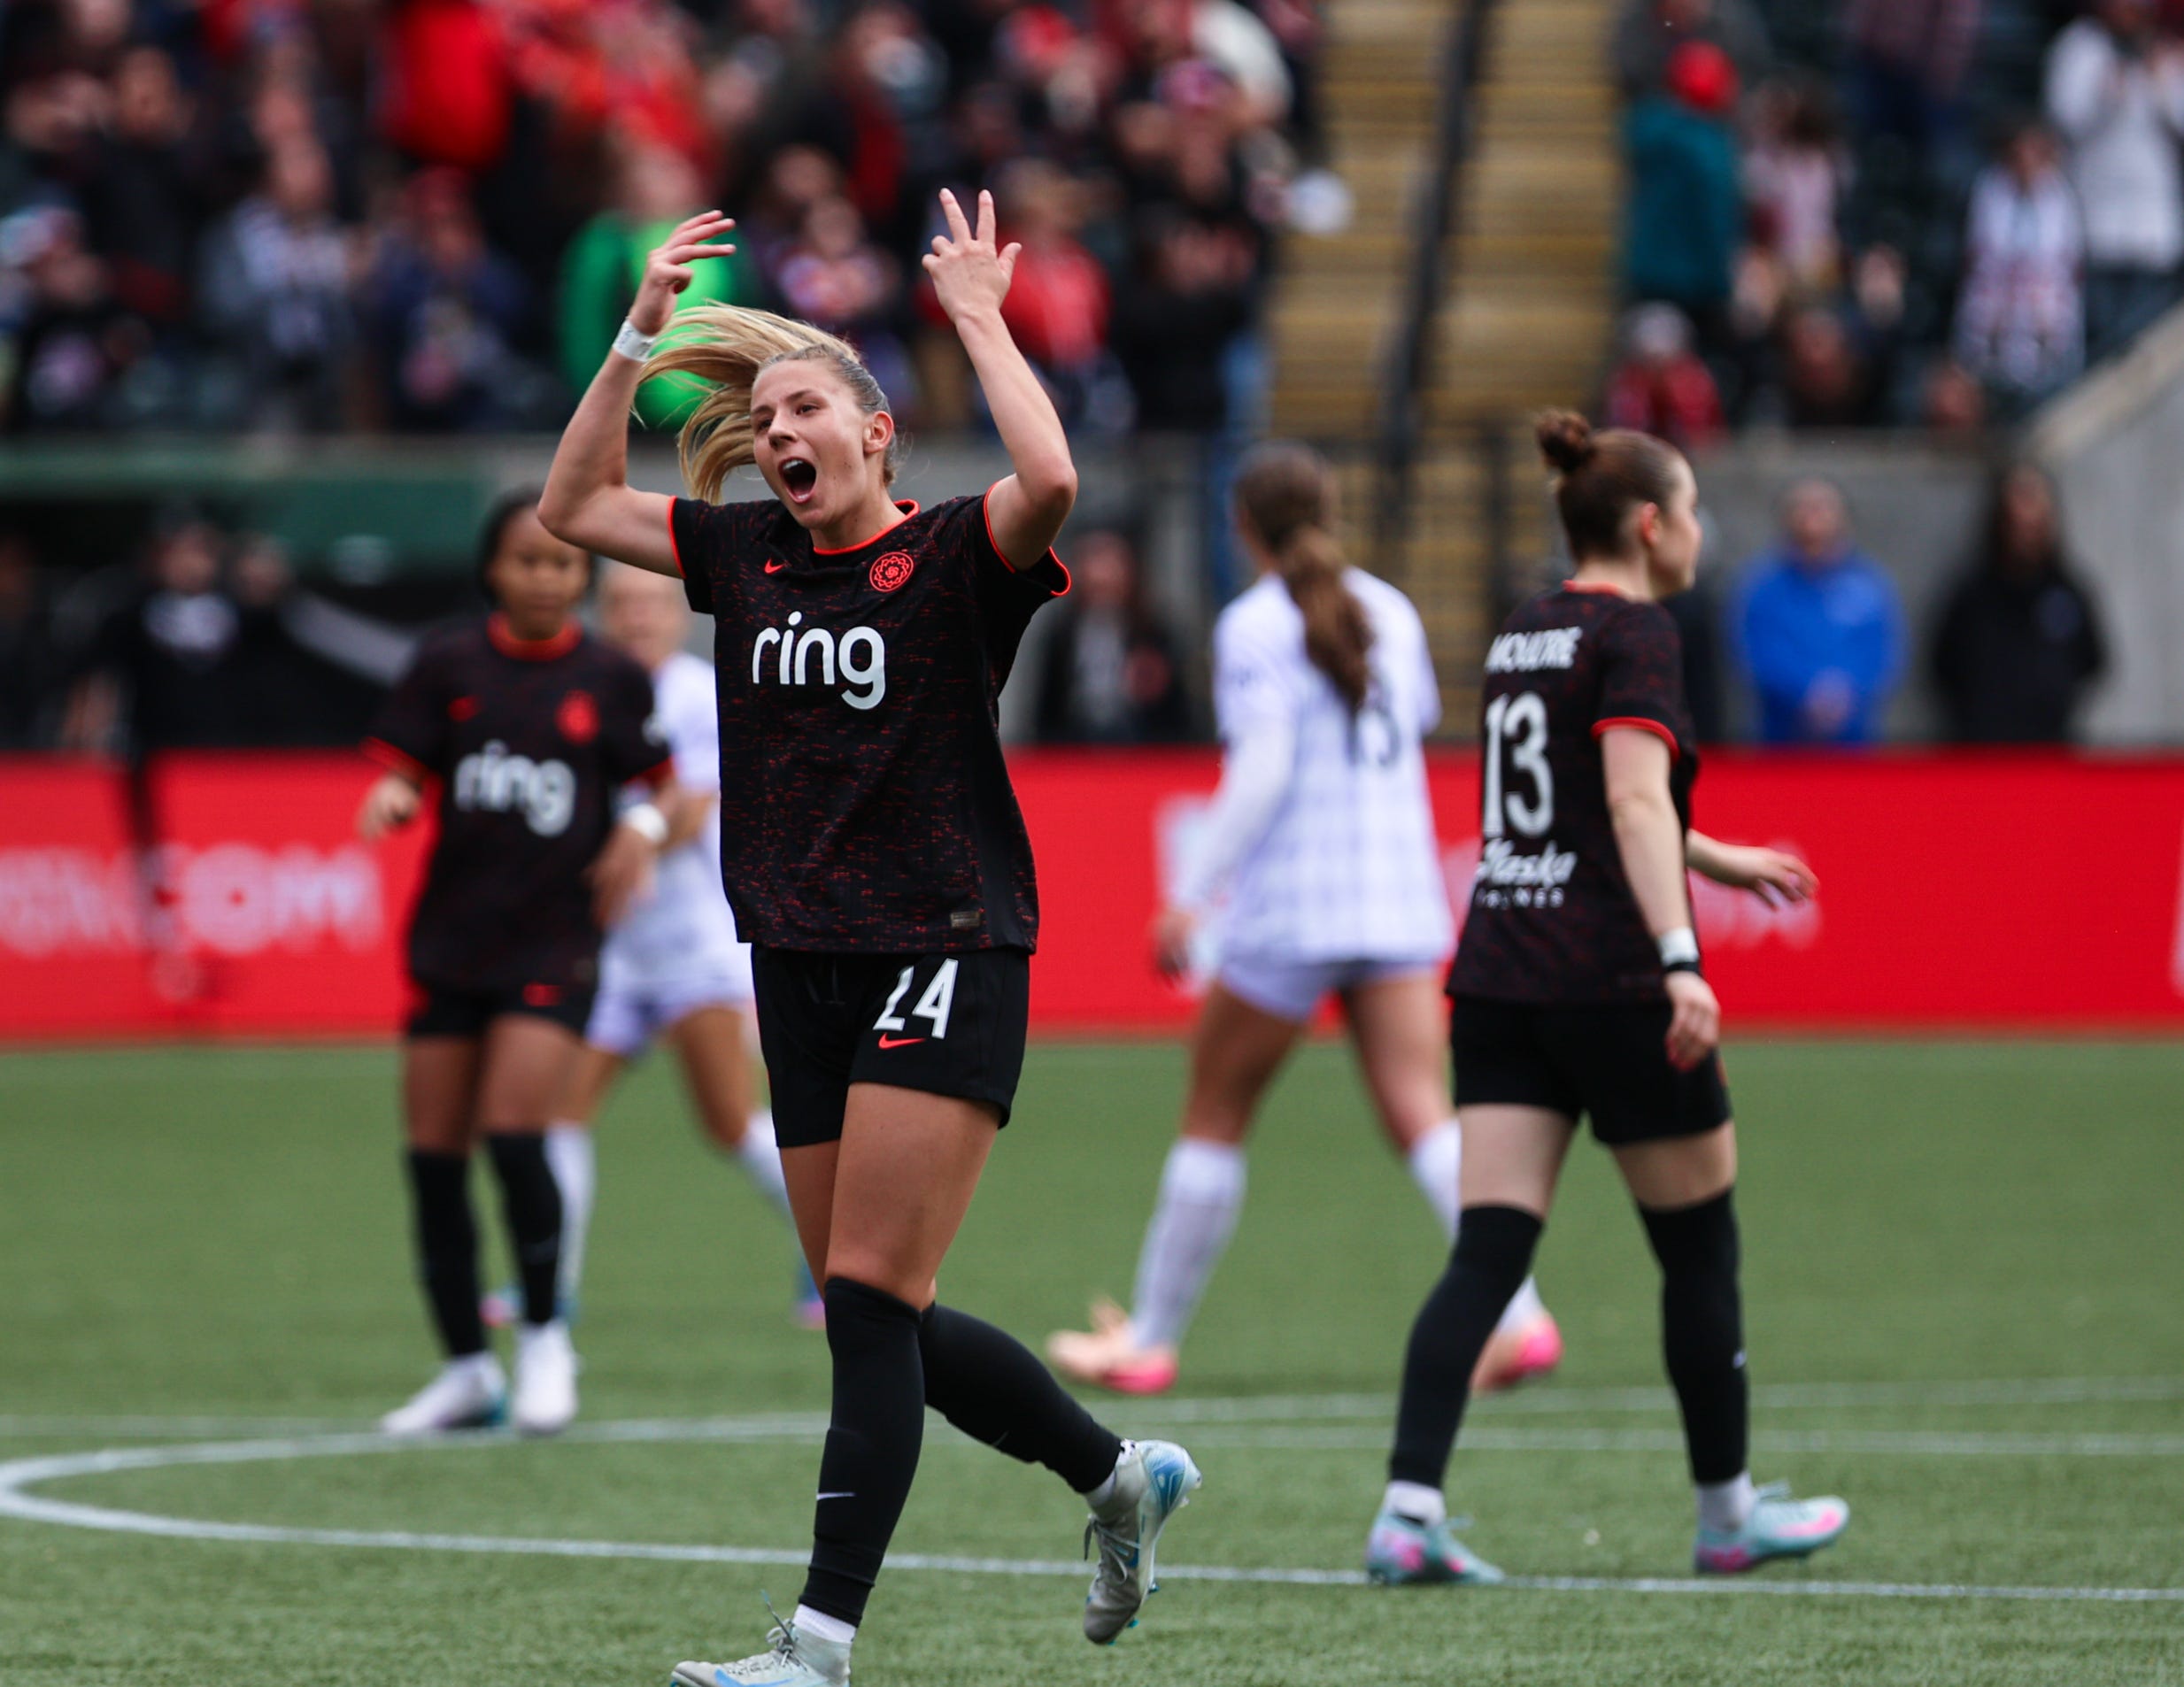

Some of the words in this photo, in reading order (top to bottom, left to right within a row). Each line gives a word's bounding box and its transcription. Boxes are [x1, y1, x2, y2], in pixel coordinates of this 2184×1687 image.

[752, 611, 885, 710] ring
[455, 739, 576, 837] ring
[1482, 690, 1554, 839] 13
[872, 957, 959, 1040] 24
